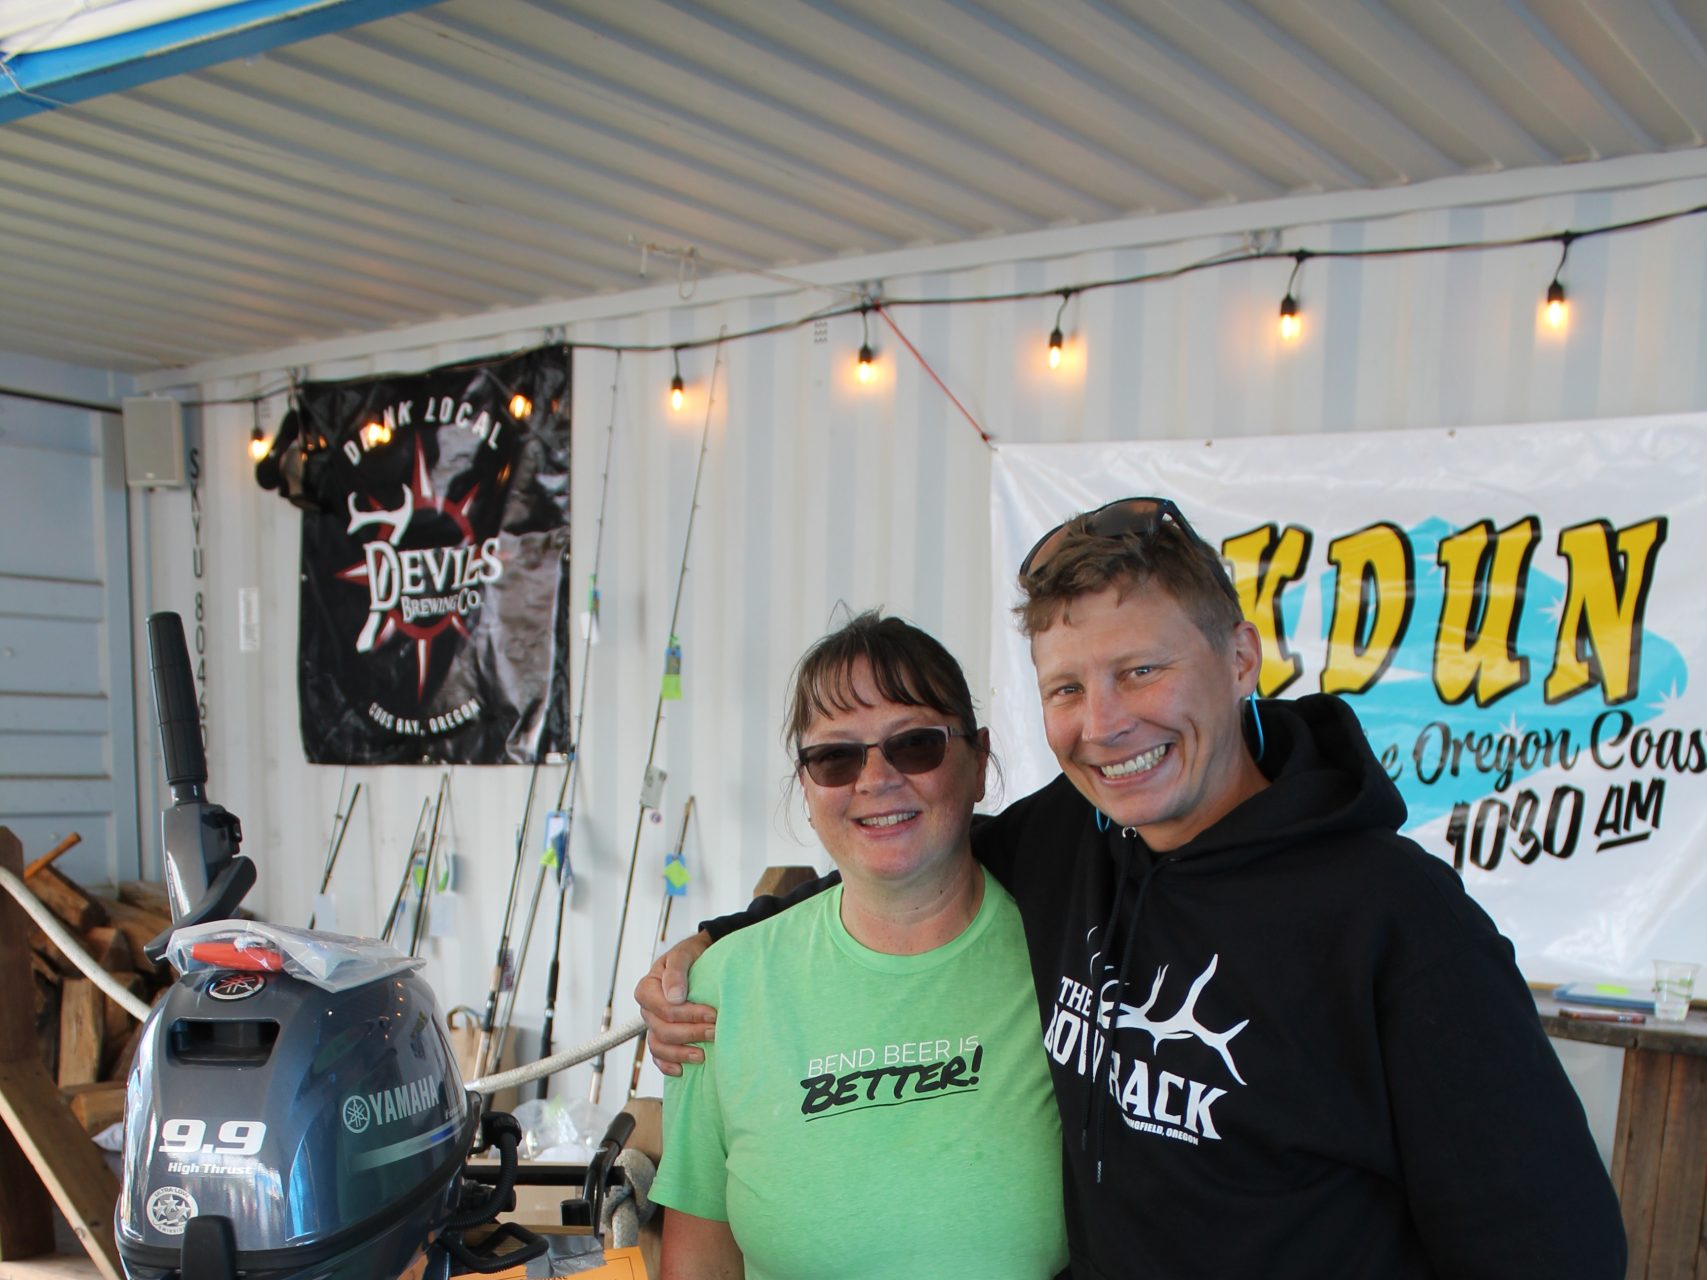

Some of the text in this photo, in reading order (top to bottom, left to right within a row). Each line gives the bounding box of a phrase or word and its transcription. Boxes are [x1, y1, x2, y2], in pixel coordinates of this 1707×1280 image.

[344, 396, 501, 466] DRNK LOCAL
[363, 538, 503, 611] DEVILS
[1221, 514, 1668, 709] KDUN
[369, 698, 482, 737] COOS BAY, OREGON
[1413, 721, 1580, 793] Oregon
[1591, 709, 1707, 774] Coas
[1446, 777, 1666, 871] 1030 AM
[1058, 975, 1094, 1016] THE
[800, 1045, 983, 1115] BETTER!
[808, 1035, 980, 1078] BEND BEER IS
[368, 1075, 439, 1126] YAMAHA
[1109, 1050, 1228, 1140] RACK
[159, 1119, 266, 1155] 9.9
[1166, 1128, 1198, 1145] OREGON
[168, 1162, 253, 1175] High Thrust
